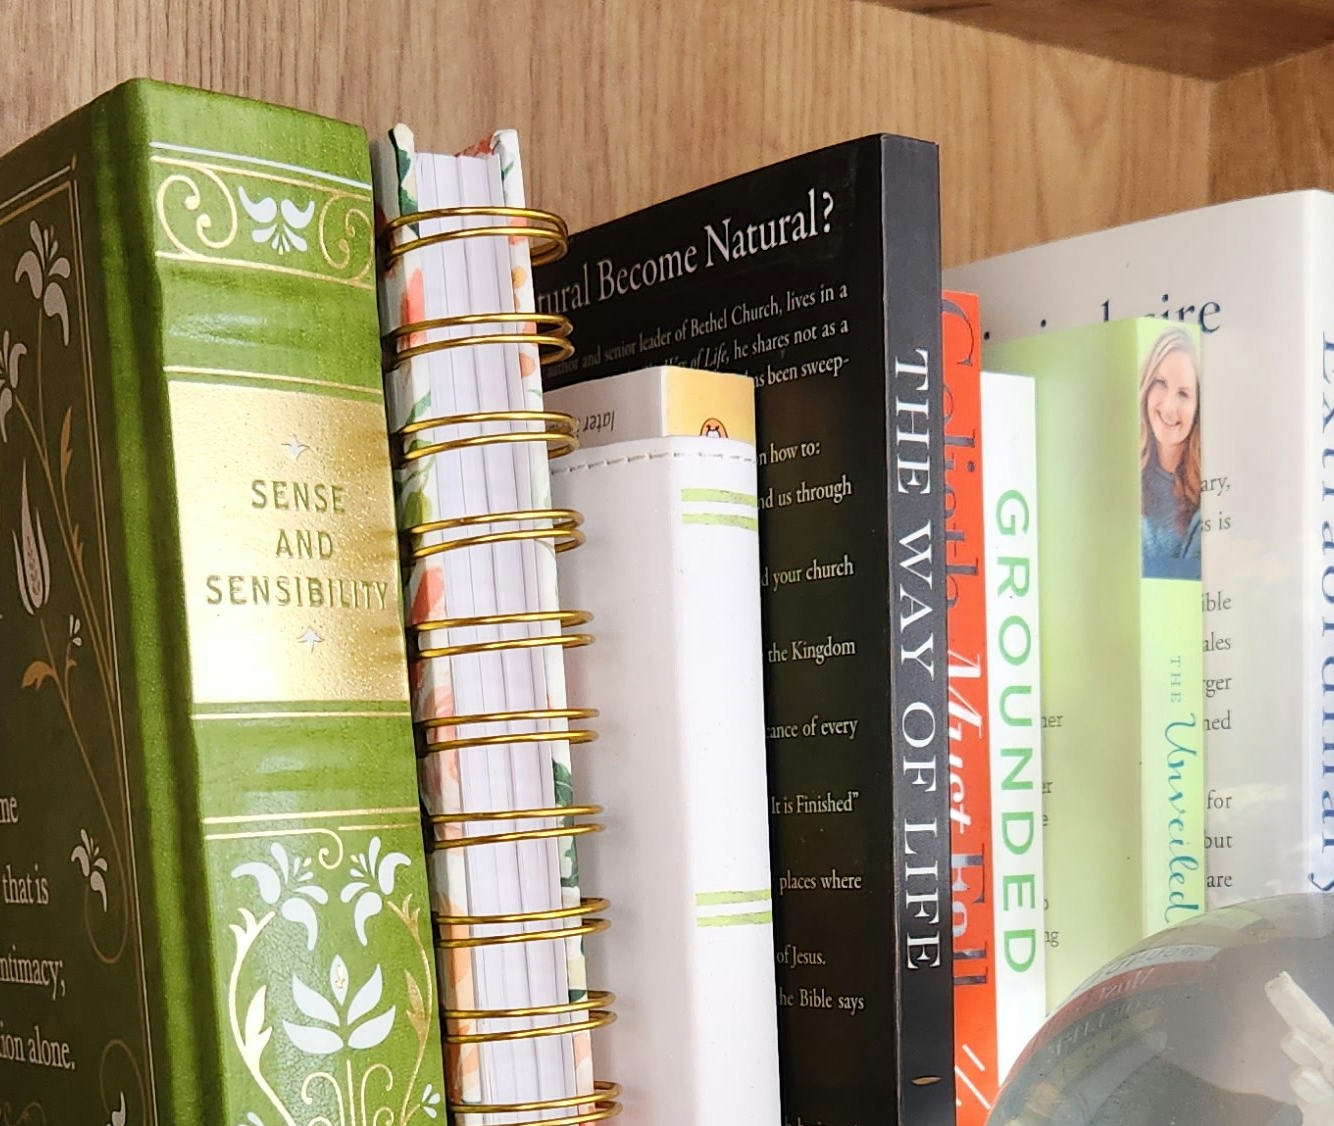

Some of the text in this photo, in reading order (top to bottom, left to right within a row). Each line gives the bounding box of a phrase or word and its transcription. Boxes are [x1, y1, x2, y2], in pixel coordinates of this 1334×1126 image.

[597, 245, 698, 301] Become
[704, 189, 834, 269] Natural?
[582, 345, 601, 368] and
[604, 340, 636, 362] senior
[639, 327, 672, 352] leader
[675, 319, 689, 341] of
[690, 308, 728, 338] Bethel
[731, 295, 783, 326] Church,
[786, 290, 816, 312] lives
[820, 283, 835, 304] in
[839, 284, 849, 299] a
[734, 339, 749, 360] he
[751, 332, 790, 355] shares
[793, 325, 819, 344] not
[821, 322, 836, 338] as
[839, 319, 849, 334] a
[767, 364, 798, 386] been
[800, 355, 850, 378] sweep-
[770, 442, 798, 464] how
[801, 441, 821, 458] to:
[251, 479, 346, 515] SENSE
[778, 490, 793, 507] us
[796, 474, 852, 504] through
[1218, 511, 1232, 531] is
[275, 528, 334, 560] AND
[773, 567, 803, 592] your
[805, 554, 855, 581] church
[205, 574, 389, 611] SENSIBILITY
[768, 635, 856, 665] the Kingdom
[895, 348, 942, 970] THE WAY OF LIFE
[1170, 655, 1182, 704] THE
[1202, 677, 1232, 698] ger
[802, 714, 819, 737] of
[820, 719, 859, 740] every
[995, 489, 1037, 973] GROUNDED
[784, 797, 794, 814] is
[1207, 789, 1233, 810] for
[2, 864, 34, 905] that
[34, 863, 49, 905] is
[779, 868, 863, 896] places where
[1206, 873, 1233, 889] are
[776, 944, 827, 969] of Jesus.
[799, 987, 833, 1009] Bible
[838, 993, 866, 1016] says
[28, 1025, 76, 1071] alone.
